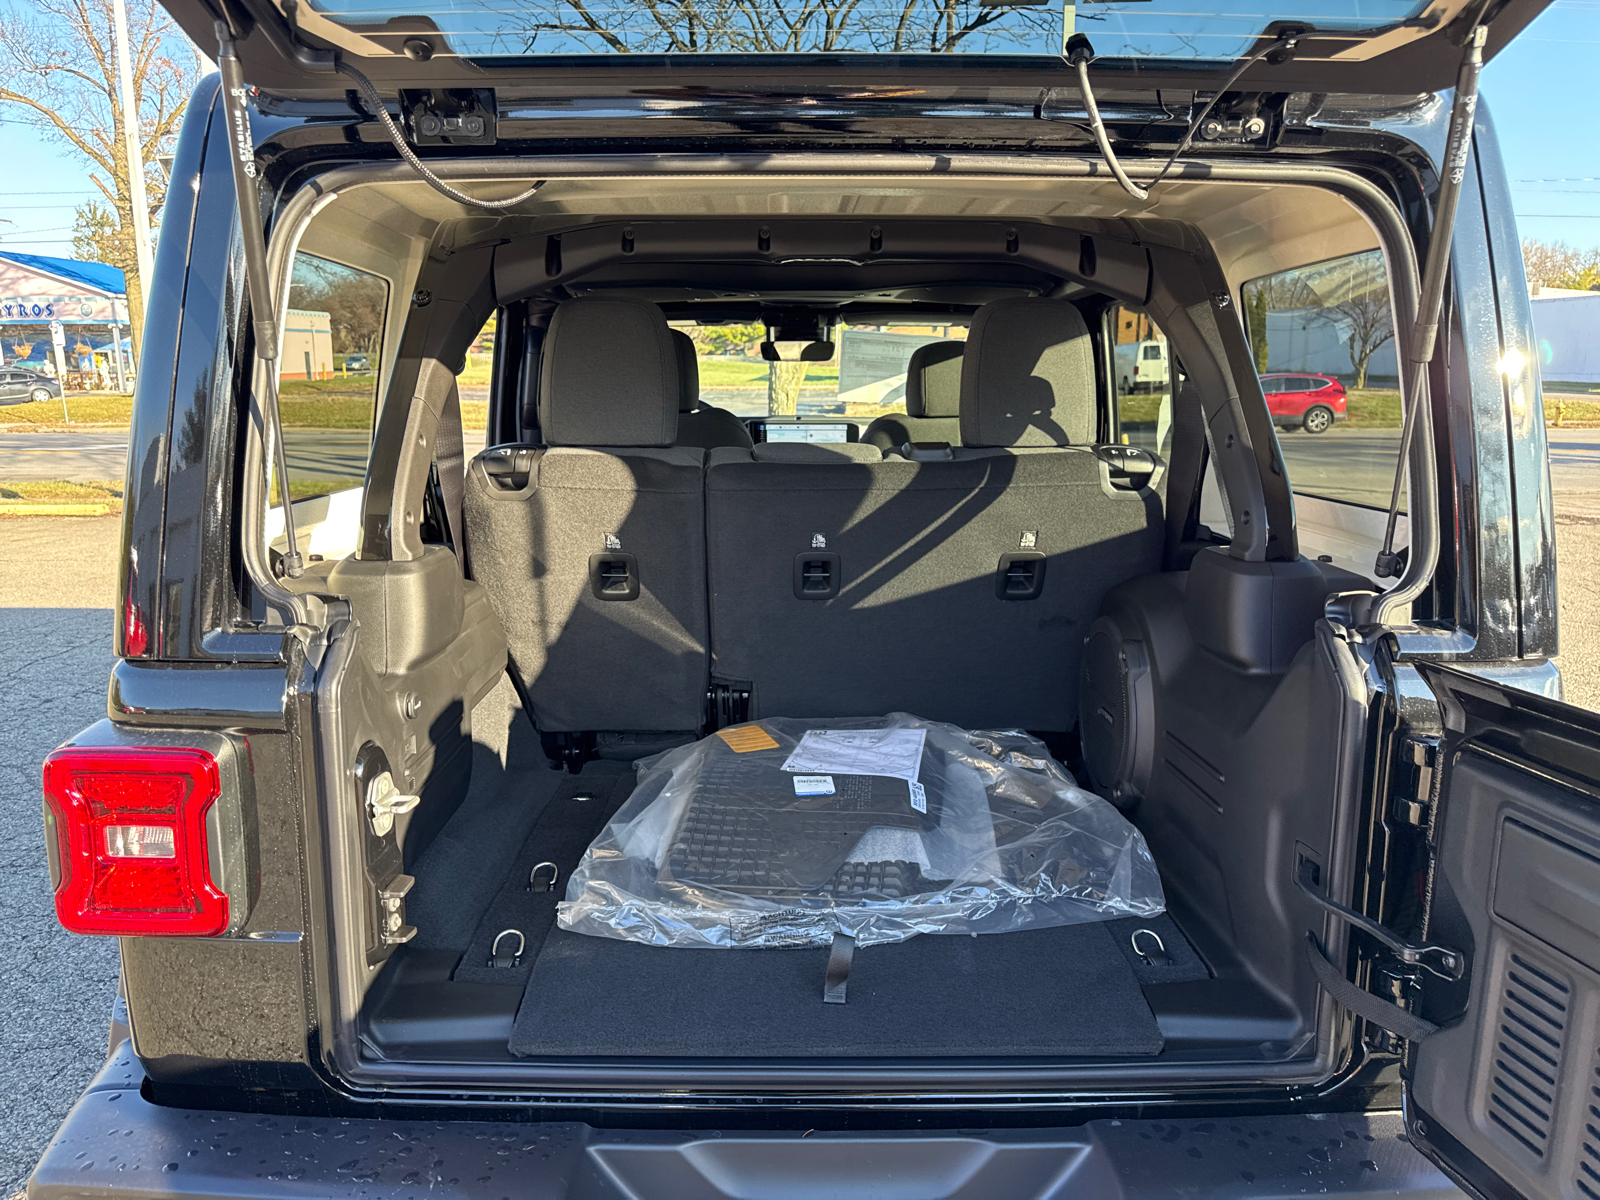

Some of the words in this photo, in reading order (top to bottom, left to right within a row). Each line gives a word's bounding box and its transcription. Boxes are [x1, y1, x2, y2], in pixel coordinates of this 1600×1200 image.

[234, 110, 246, 161] STABILUS
[1449, 117, 1463, 168] STABILUS
[0, 303, 55, 318] YROS
